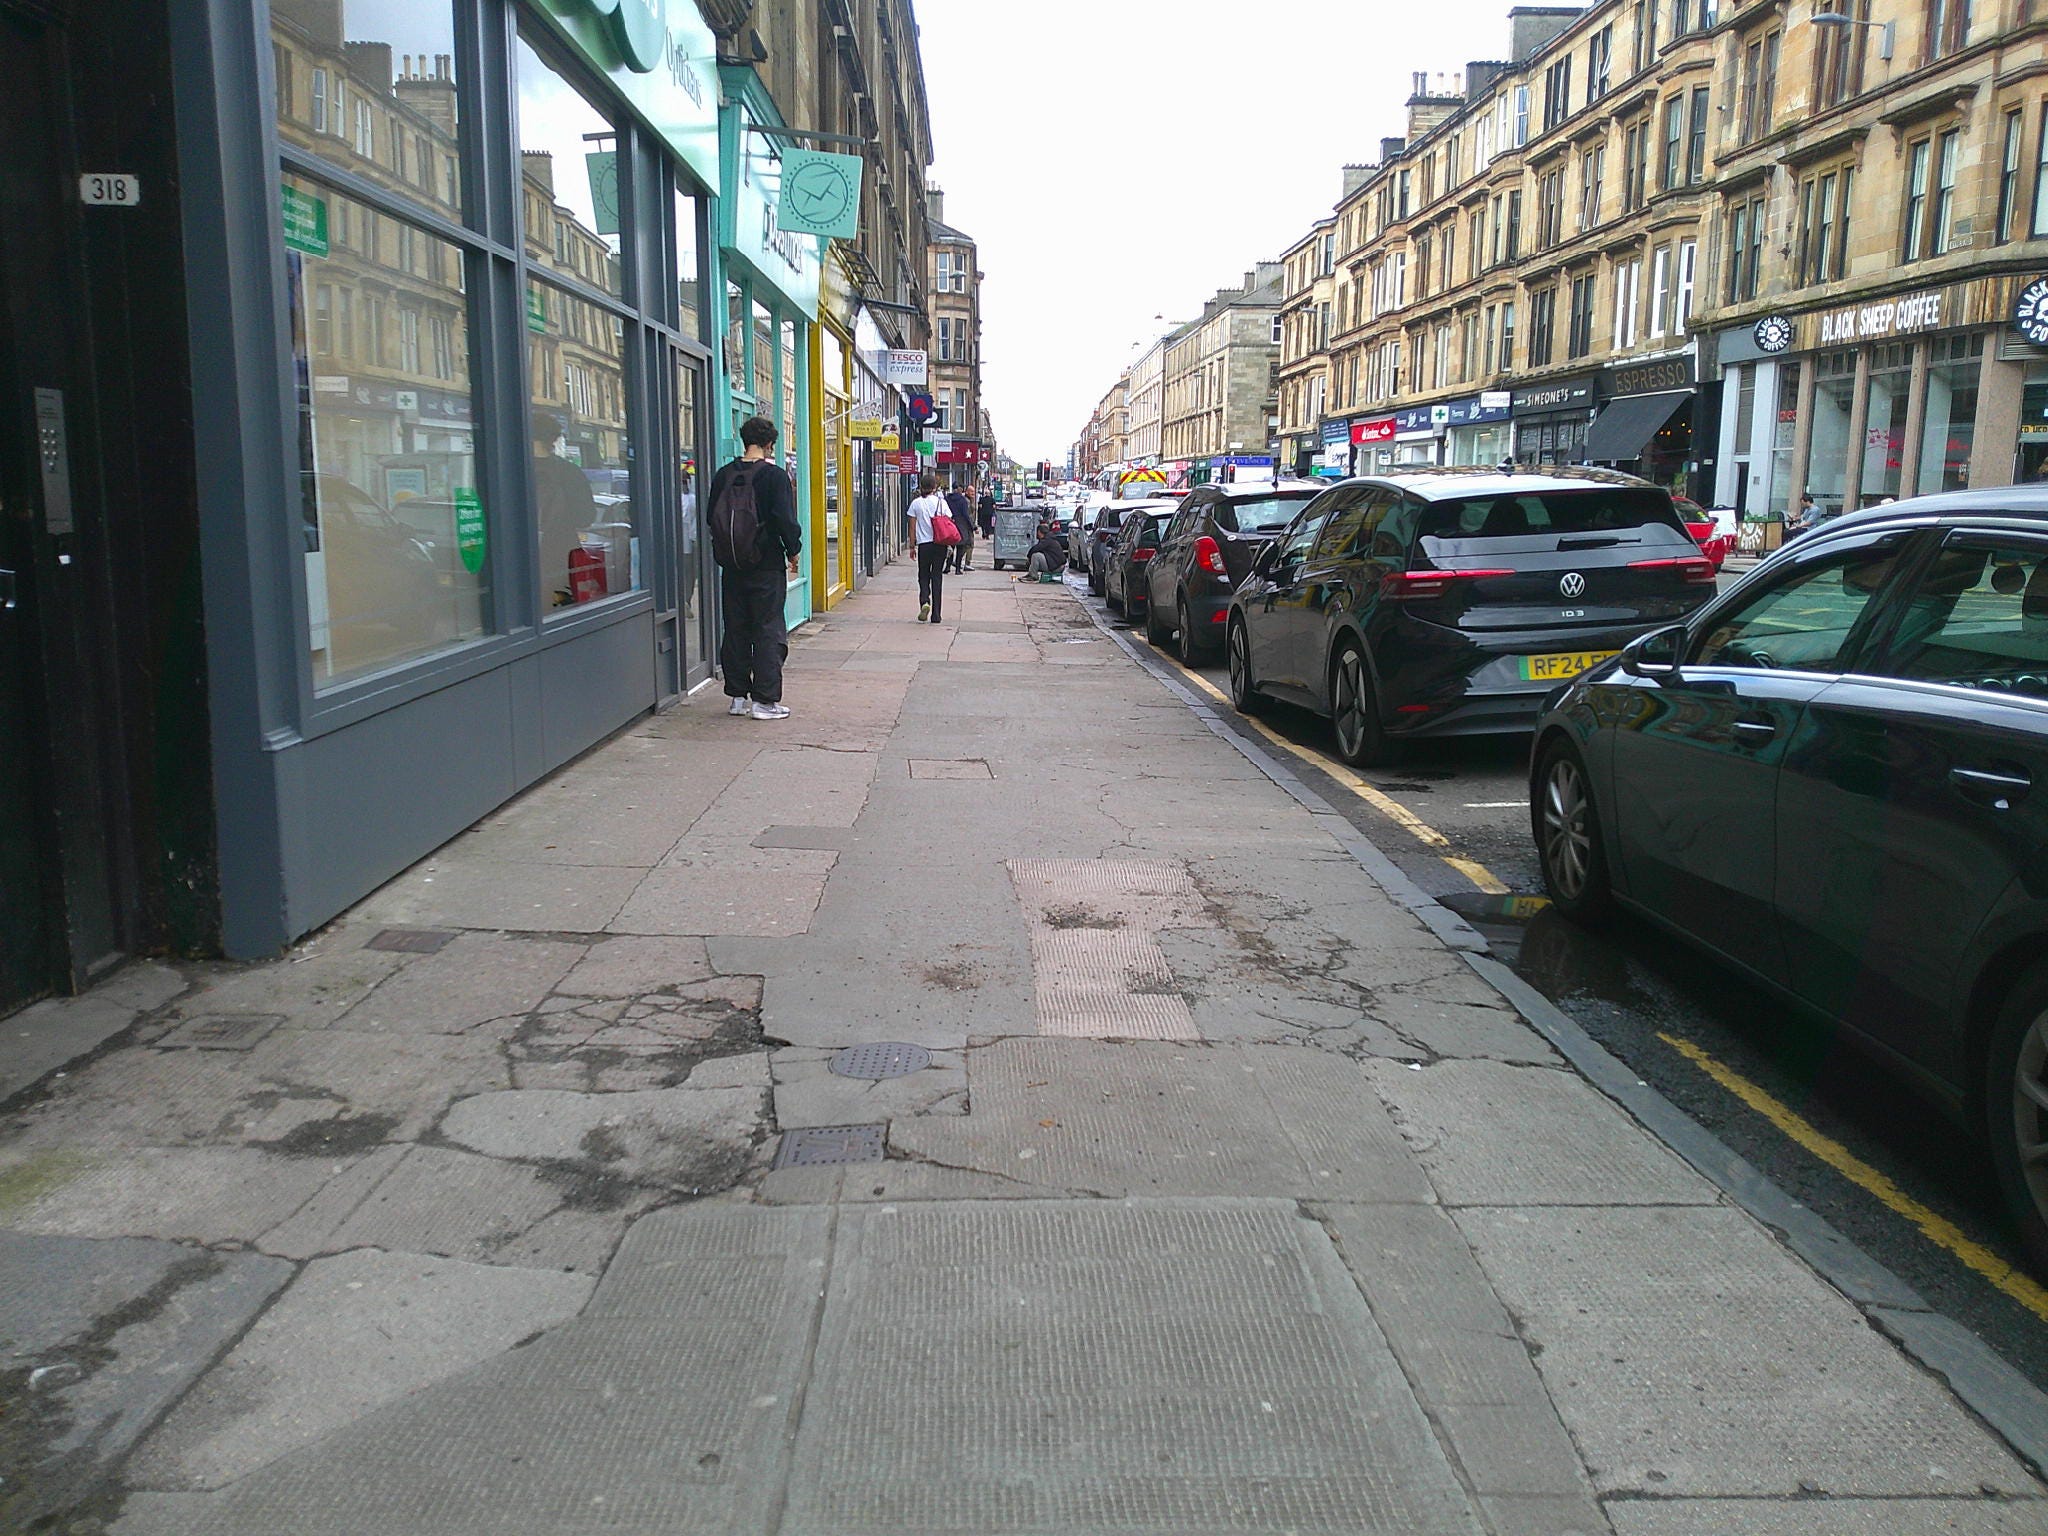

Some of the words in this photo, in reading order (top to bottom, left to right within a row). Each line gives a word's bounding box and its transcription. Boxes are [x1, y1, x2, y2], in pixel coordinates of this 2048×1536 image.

[92, 178, 126, 200] 318
[1821, 310, 1856, 341] BLACK
[1859, 303, 1894, 335] SHEEP
[1895, 294, 1941, 329] COFFEE
[890, 353, 924, 361] TESCO
[890, 365, 924, 375] express
[1615, 362, 1686, 393] ESPRESSO
